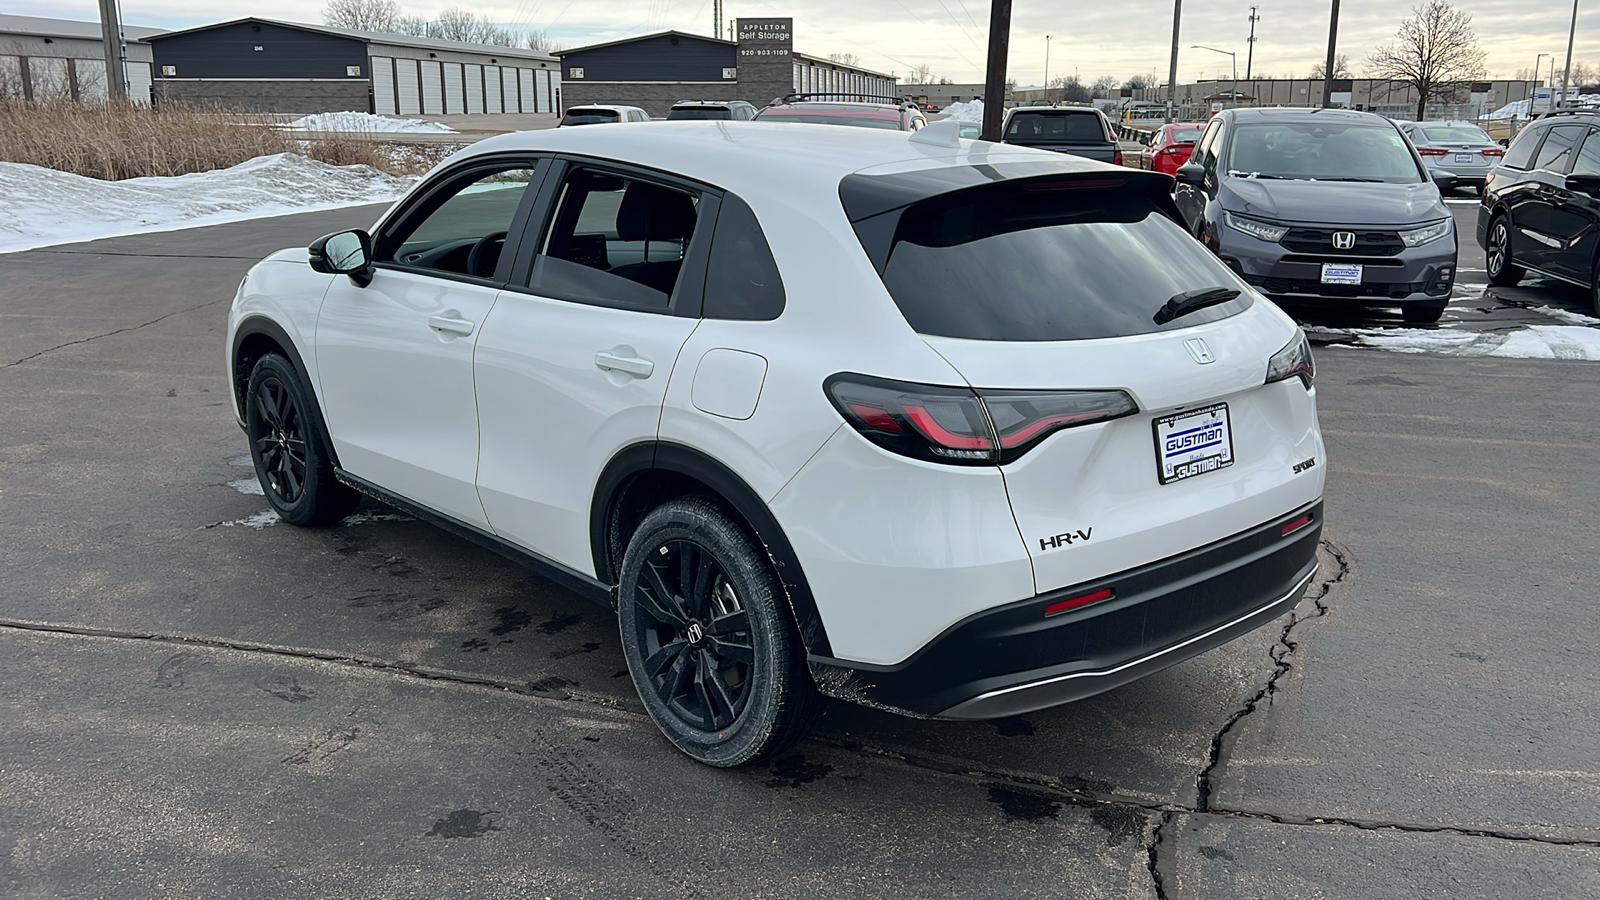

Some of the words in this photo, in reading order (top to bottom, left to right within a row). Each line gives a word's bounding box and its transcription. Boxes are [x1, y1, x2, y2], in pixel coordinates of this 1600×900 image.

[739, 31, 755, 40] Self
[758, 31, 790, 41] Storage
[1292, 457, 1315, 474] SPORT
[1039, 526, 1092, 551] HR-V
